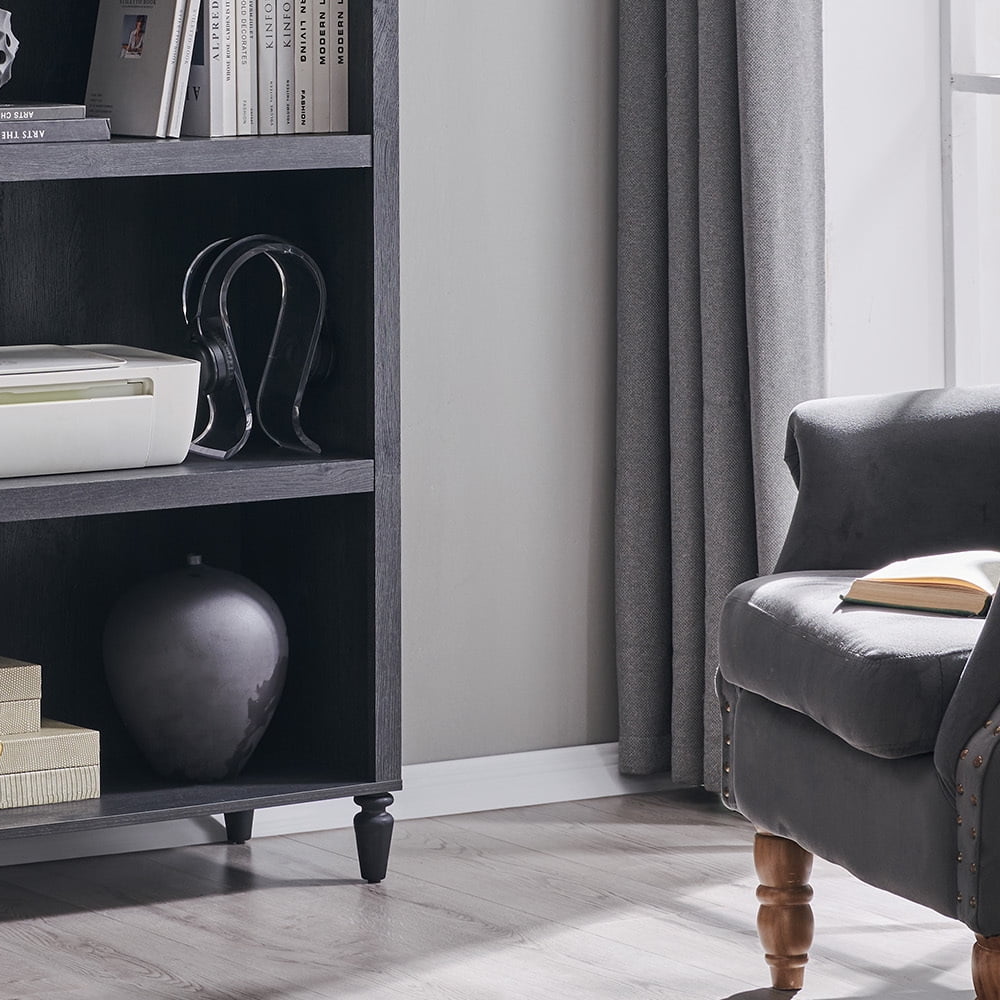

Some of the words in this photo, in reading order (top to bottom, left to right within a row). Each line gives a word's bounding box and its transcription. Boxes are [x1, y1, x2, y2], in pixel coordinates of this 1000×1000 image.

[211, 0, 220, 61] ALPRED
[14, 111, 34, 119] ARTS
[1, 130, 19, 139] THE
[22, 130, 45, 138] ARTS
